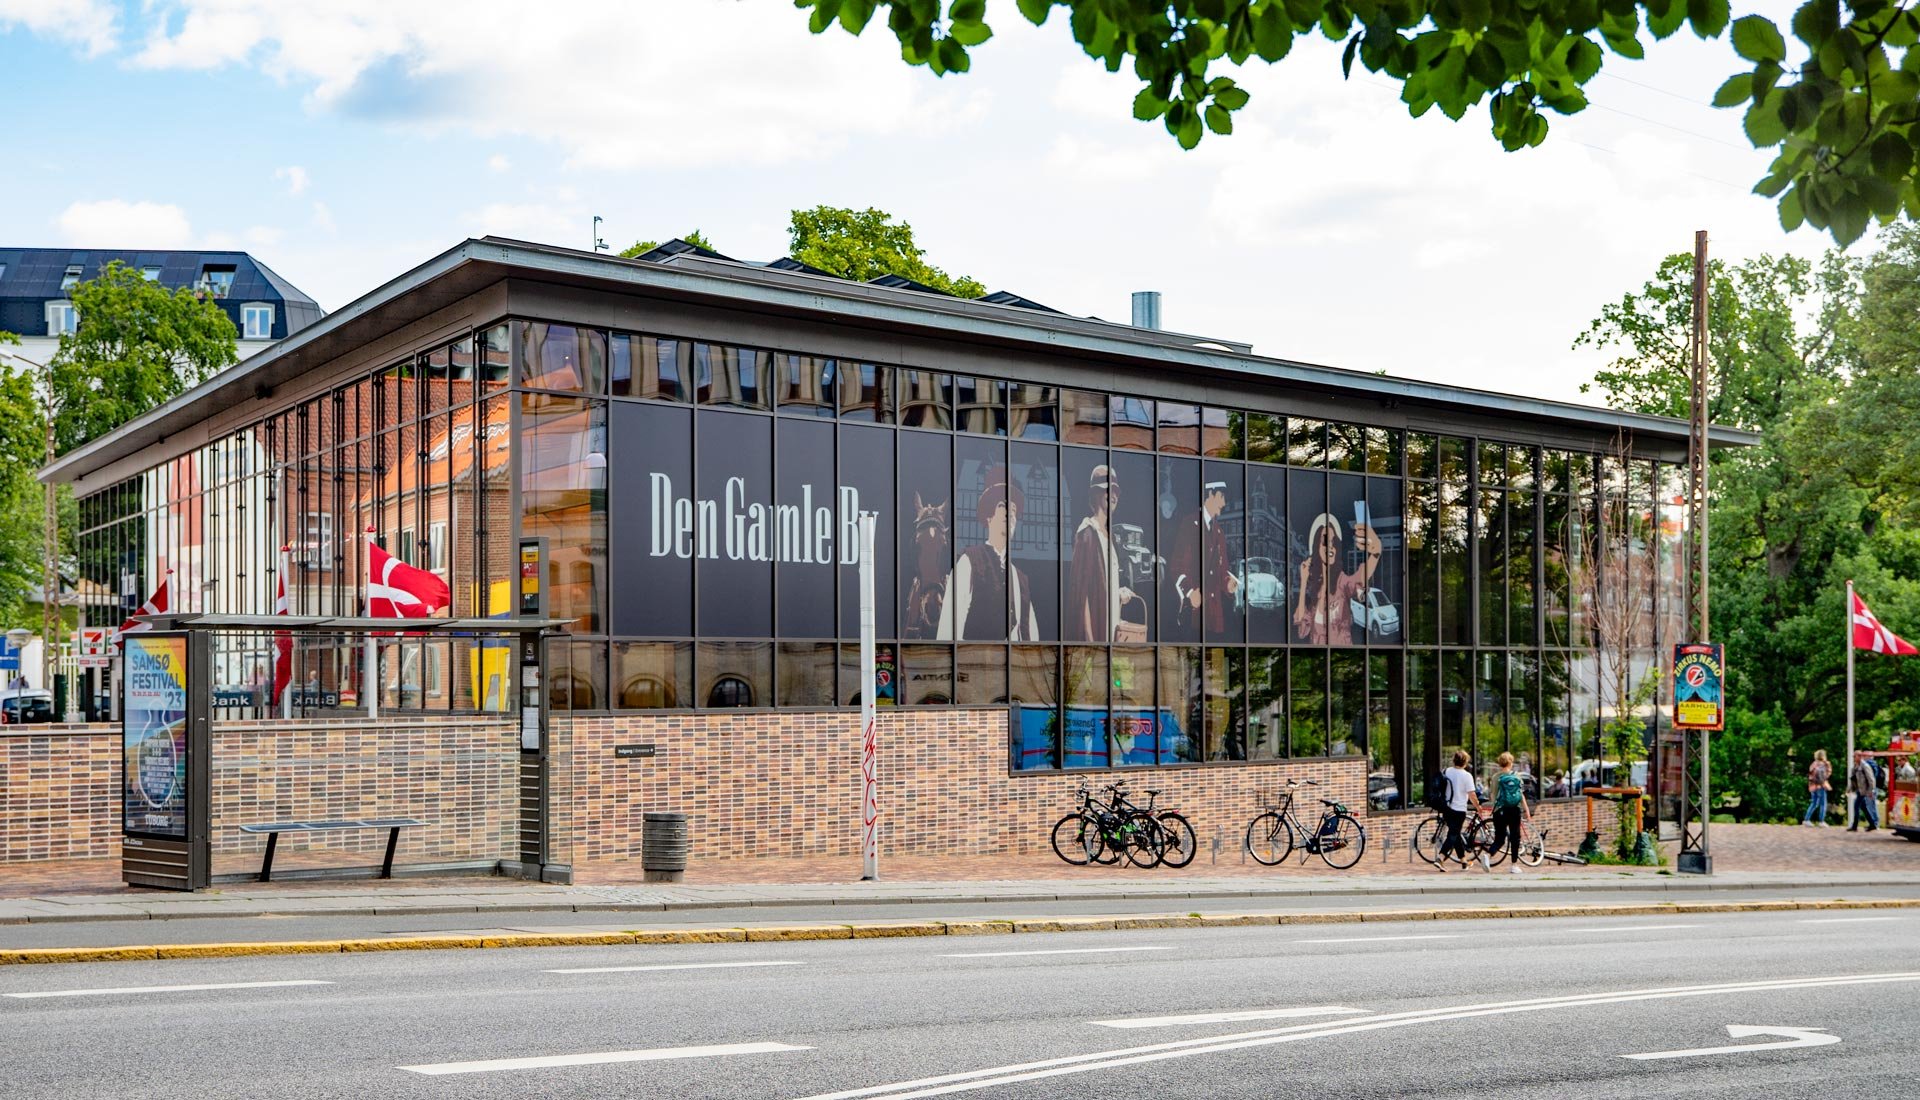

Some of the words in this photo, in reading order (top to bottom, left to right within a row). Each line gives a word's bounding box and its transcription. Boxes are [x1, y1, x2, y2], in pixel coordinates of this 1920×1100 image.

[650, 472, 719, 559] Den
[725, 477, 832, 565] Gamle
[839, 486, 879, 573] B
[132, 654, 170, 671] SAMSØ
[1673, 654, 1698, 677] ZIRKUS
[1699, 654, 1722, 677] NEMO
[132, 673, 182, 689] FESTIVAL
